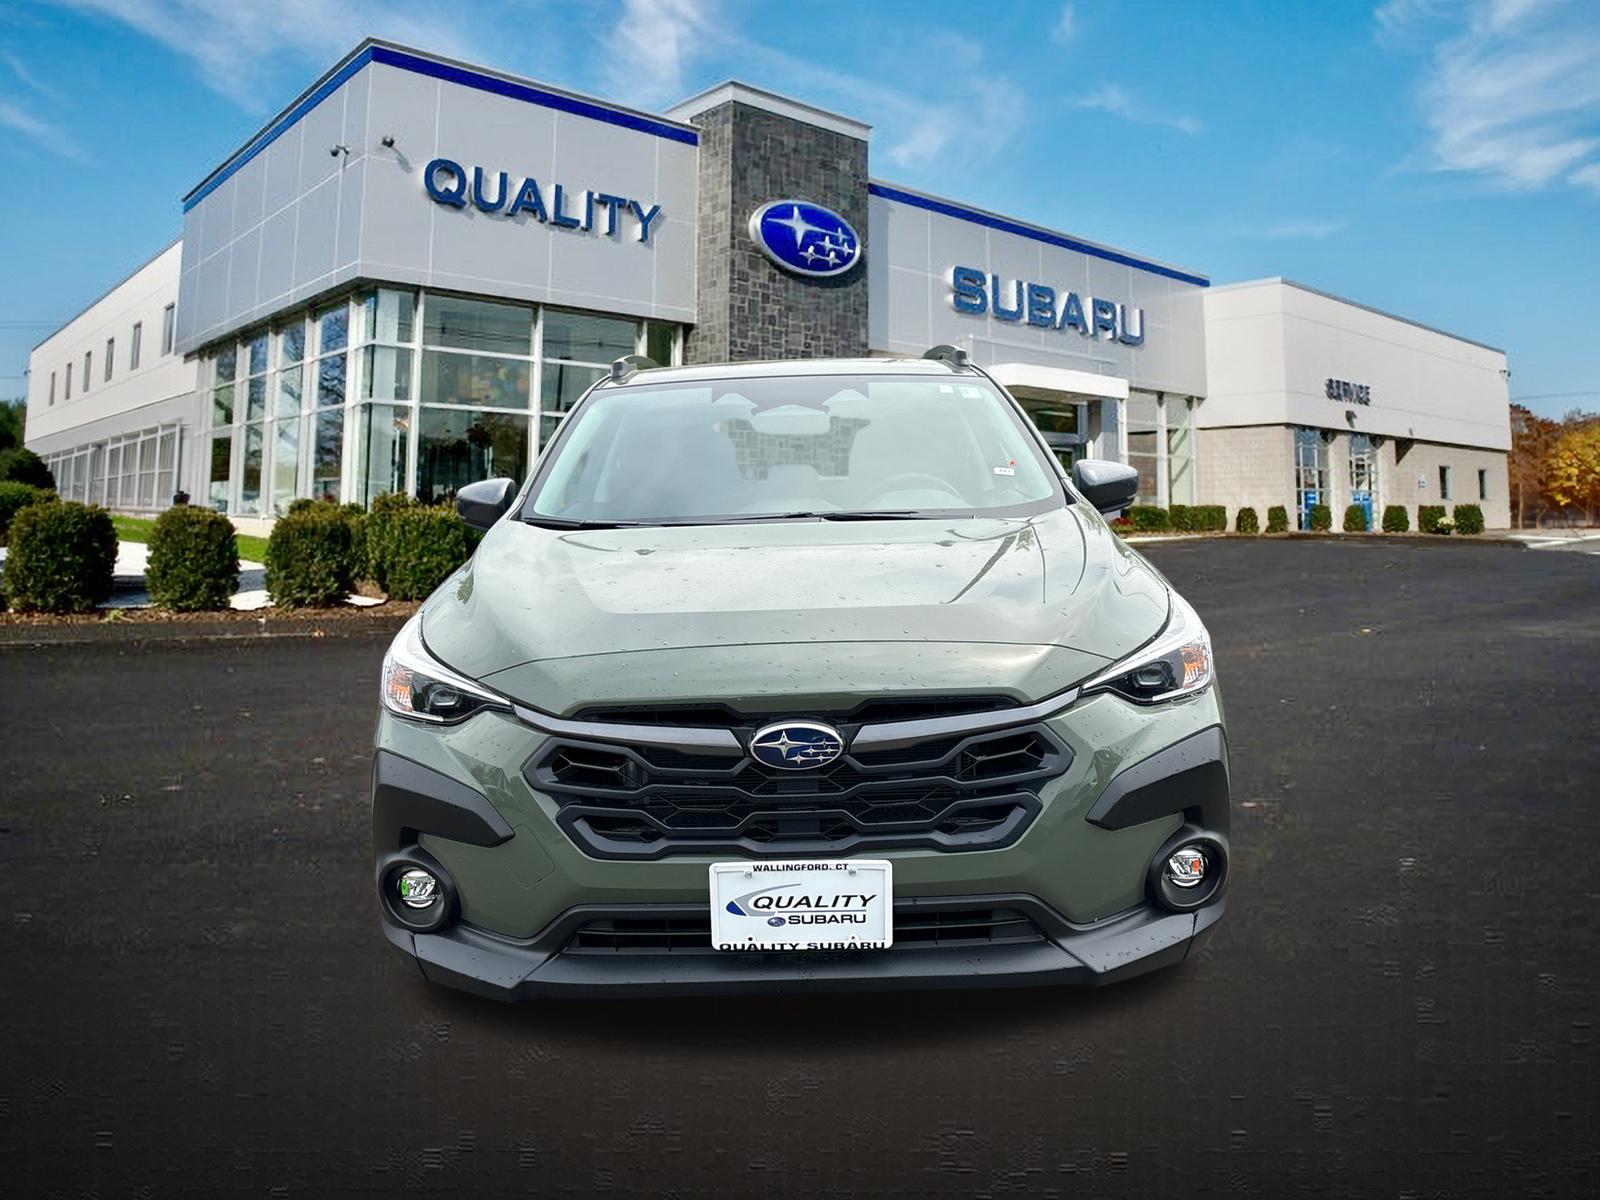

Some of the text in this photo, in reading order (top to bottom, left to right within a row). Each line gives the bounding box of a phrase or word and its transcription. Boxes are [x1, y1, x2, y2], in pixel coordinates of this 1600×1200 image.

[423, 158, 661, 242] QUALITY
[952, 265, 1145, 346] SUBARU
[836, 863, 849, 871] CT
[753, 894, 877, 910] QUALITY
[788, 914, 867, 925] SUBARU
[719, 942, 885, 951] QUALITY SUBARU
